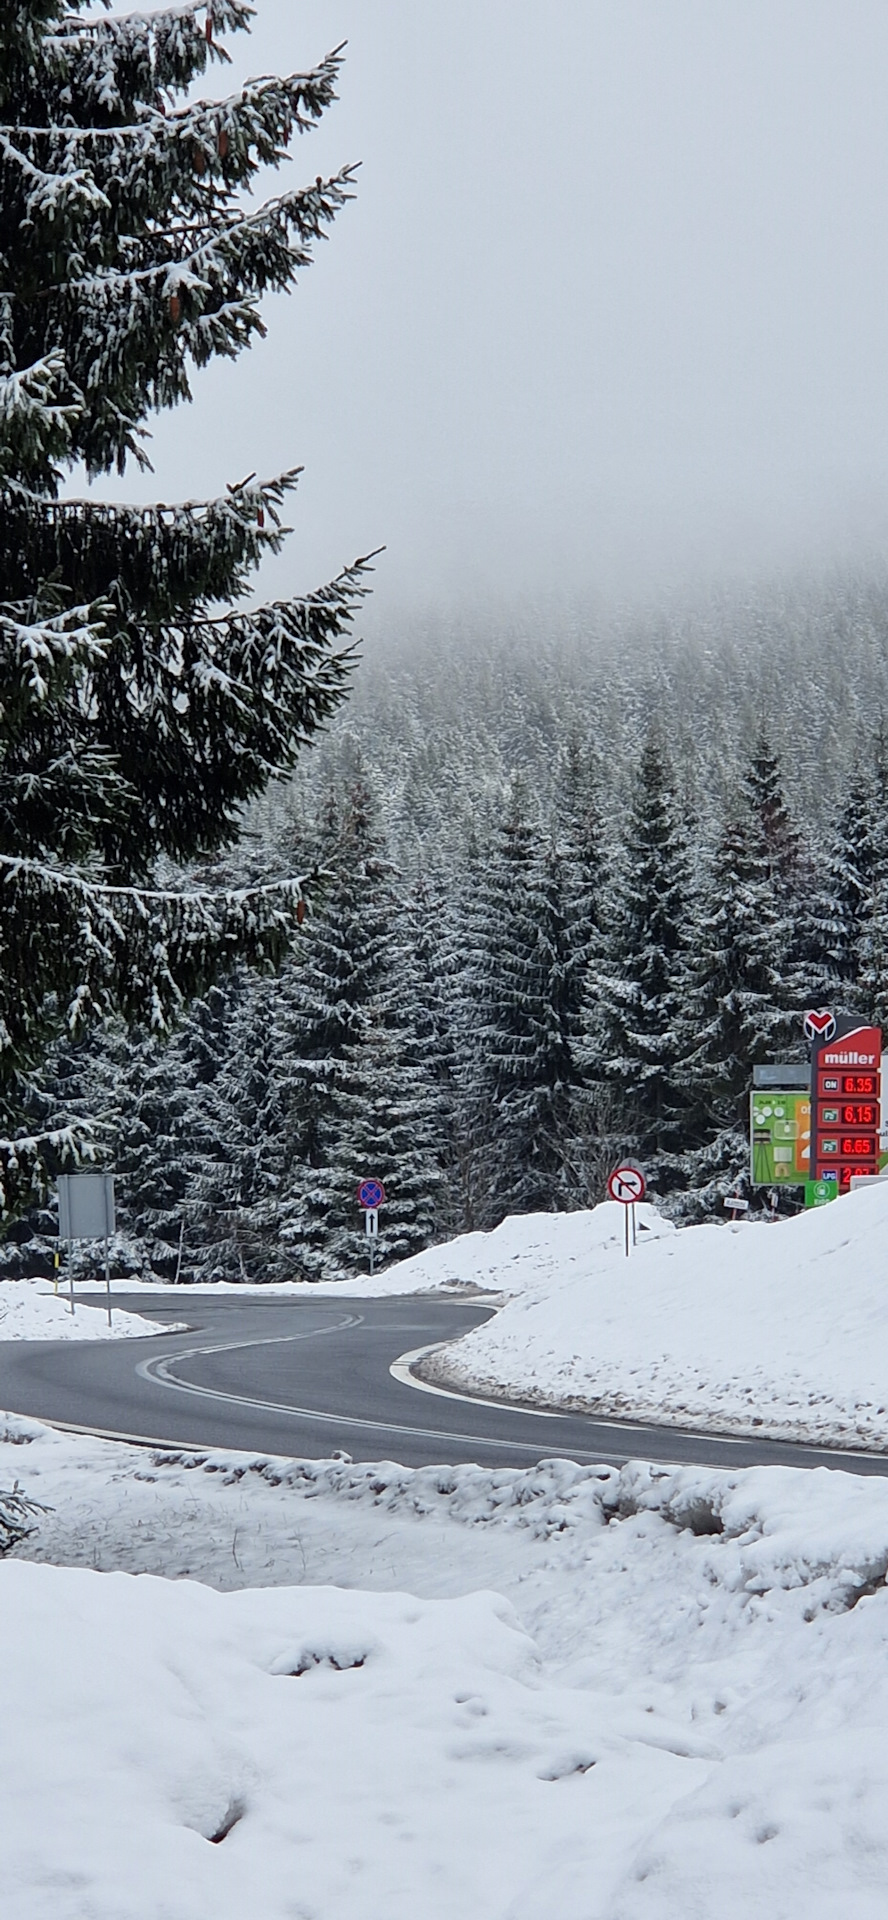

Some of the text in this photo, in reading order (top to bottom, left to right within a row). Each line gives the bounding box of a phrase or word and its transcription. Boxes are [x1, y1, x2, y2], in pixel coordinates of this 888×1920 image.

[825, 1051, 875, 1064] müller
[825, 1078, 873, 1092] ON 6.35
[843, 1139, 871, 1154] 6.65
